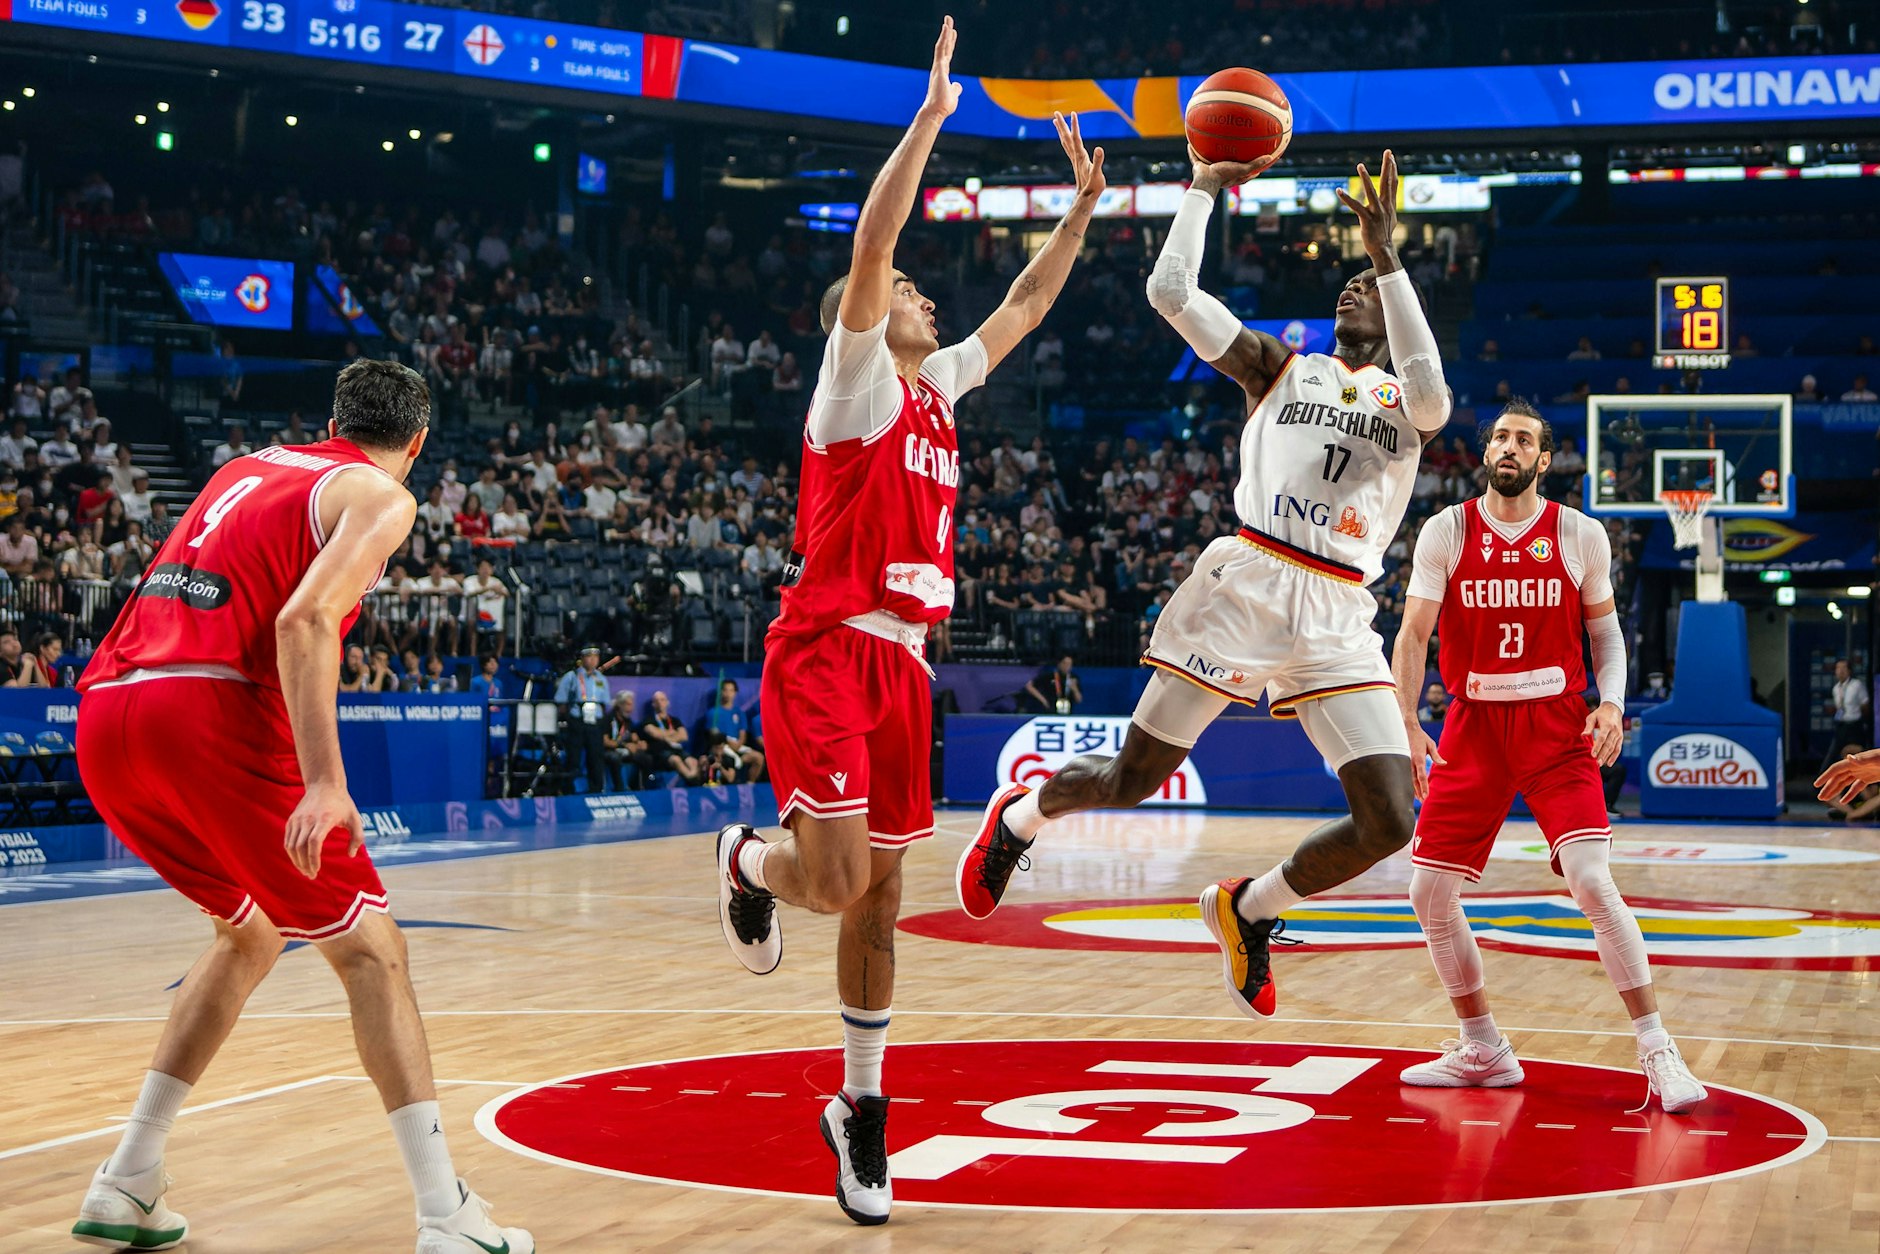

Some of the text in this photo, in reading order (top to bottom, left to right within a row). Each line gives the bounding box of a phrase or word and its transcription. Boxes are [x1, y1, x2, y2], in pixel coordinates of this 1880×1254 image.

[67, 3, 108, 18] FOULS
[136, 8, 147, 25] 3
[242, 1, 286, 33] 33
[309, 18, 381, 52] 5:16
[404, 21, 444, 51] 27
[530, 57, 540, 72] 3
[1653, 67, 1880, 110] OKINAW
[1206, 113, 1253, 128] molten
[1682, 311, 1719, 350] 18
[1674, 354, 1731, 369] TISSOT
[1276, 401, 1398, 454] DEUTSCHLAND
[1322, 443, 1352, 484] 17
[1273, 494, 1331, 527] ING
[1460, 578, 1562, 608] GEORGIA
[1499, 622, 1525, 659] 23
[46, 705, 78, 723] FIBA
[339, 705, 482, 721] BASKETBALL WORLD CUP 2023
[1670, 743, 1734, 760] 百岁山
[373, 811, 411, 836] ALL
[8, 847, 47, 866] 2023
[887, 1056, 1383, 1181] TCL
